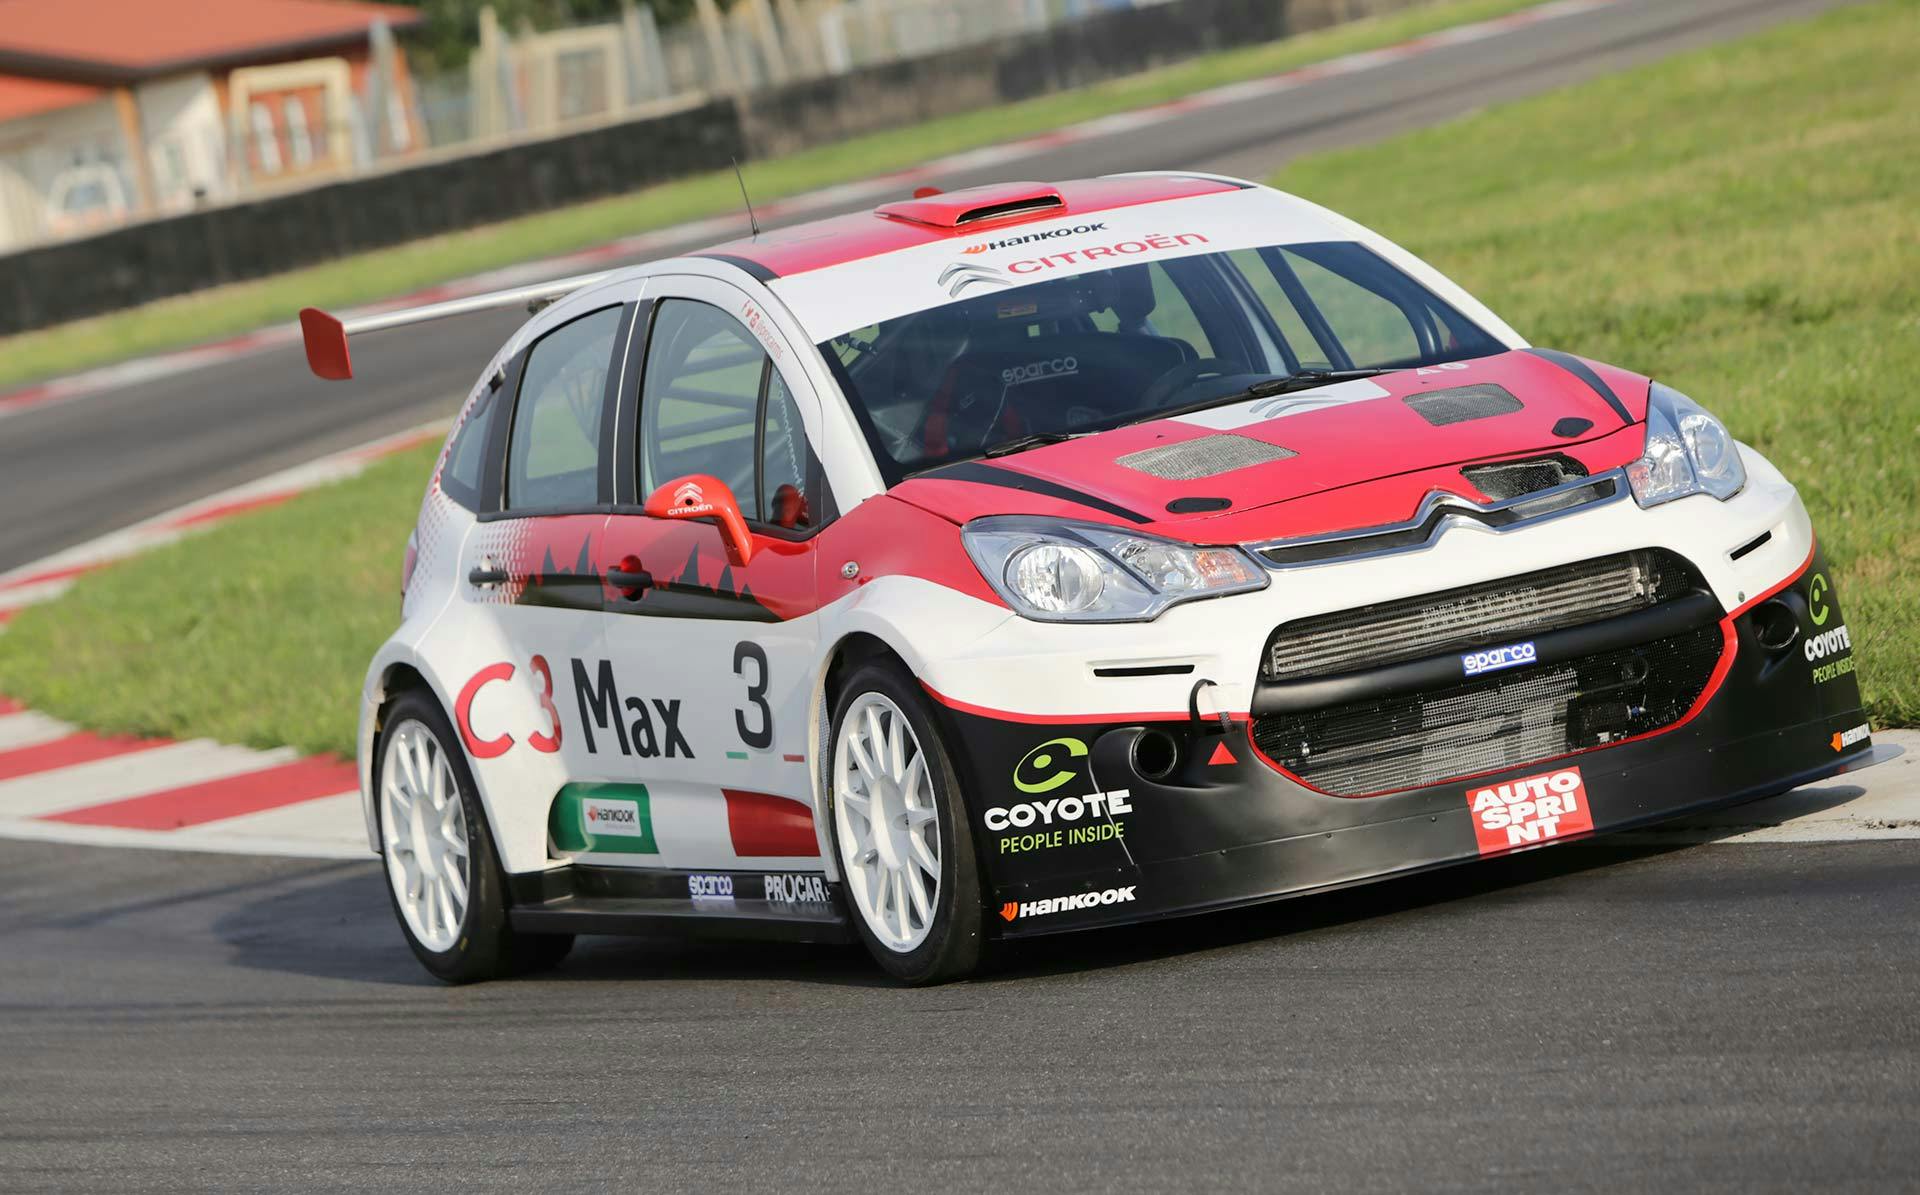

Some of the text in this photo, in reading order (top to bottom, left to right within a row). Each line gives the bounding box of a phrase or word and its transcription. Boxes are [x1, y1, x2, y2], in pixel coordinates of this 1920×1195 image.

[1804, 624, 1851, 662] COYOTE
[1812, 663, 1837, 684] PEOPLE
[454, 653, 696, 759] C3 Max
[733, 640, 773, 750] 3
[984, 789, 1133, 831] COYOTE
[1473, 771, 1581, 813] AUTO
[1481, 791, 1578, 830] SPRI
[1000, 822, 1125, 854] PEOPLE INSIDE
[1507, 815, 1560, 845] NT
[764, 874, 827, 903] PROCAR
